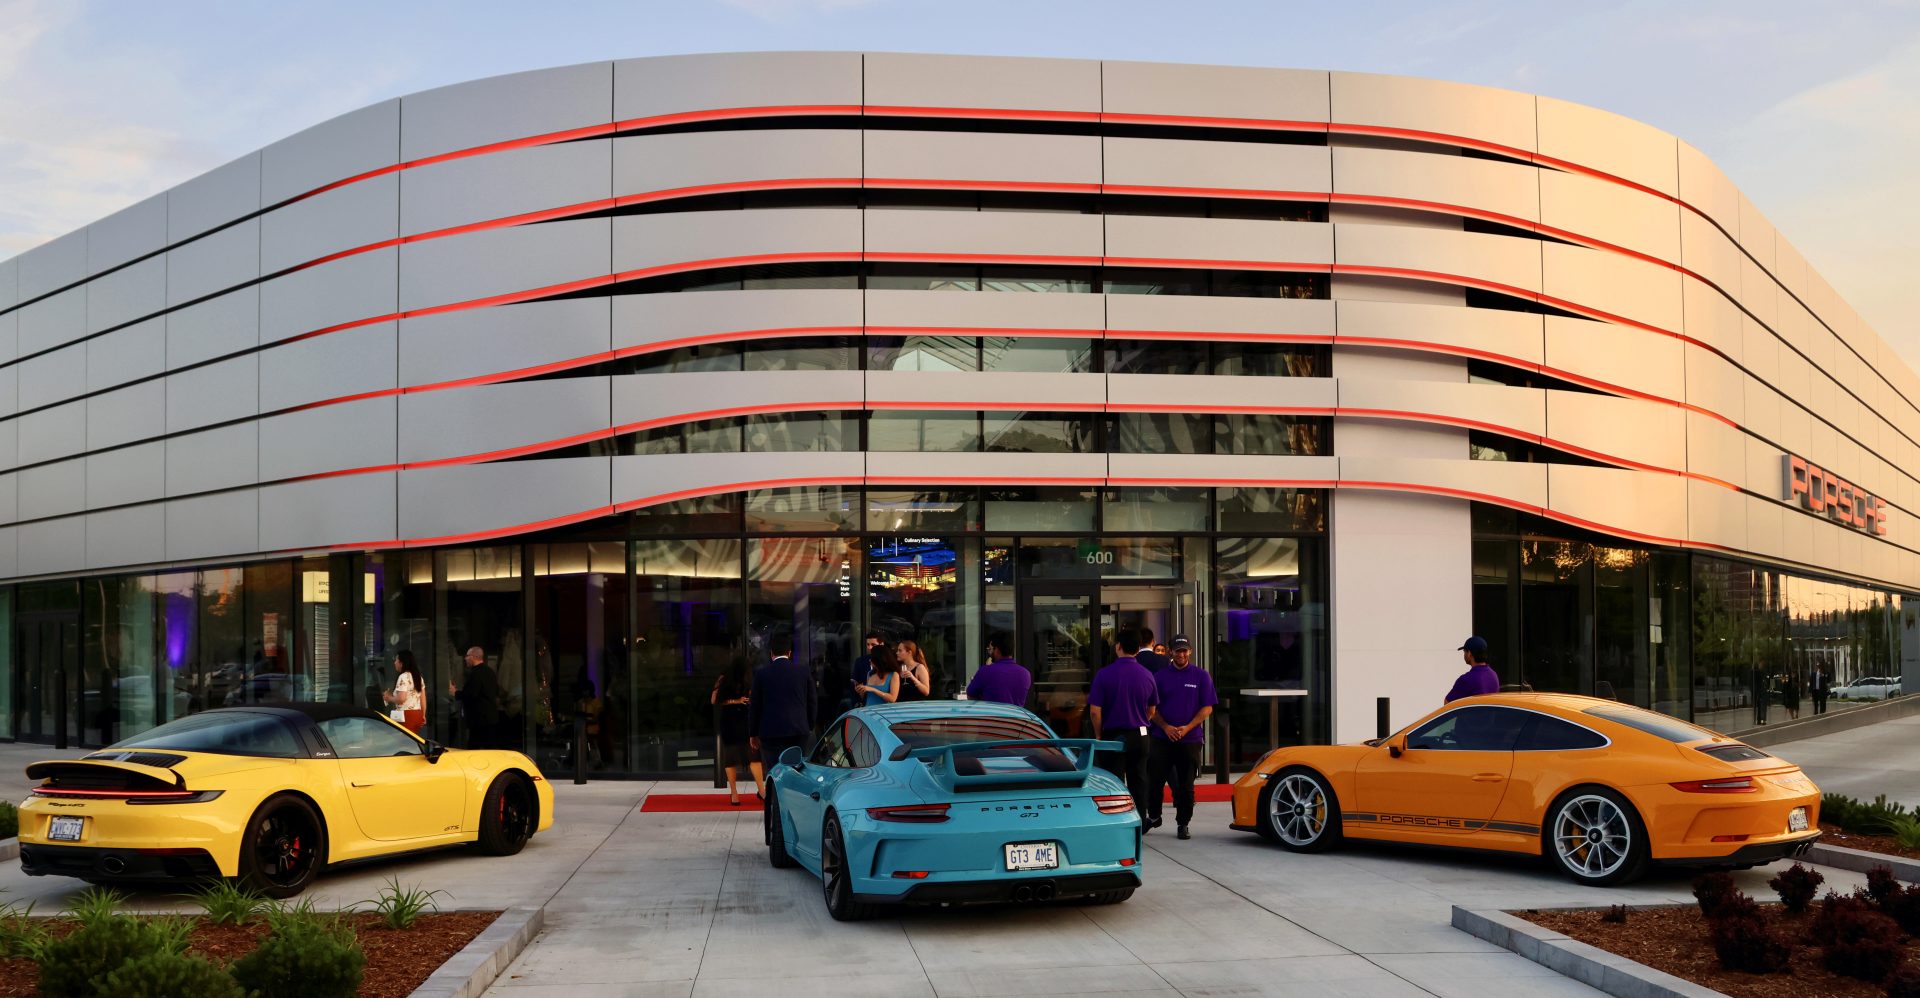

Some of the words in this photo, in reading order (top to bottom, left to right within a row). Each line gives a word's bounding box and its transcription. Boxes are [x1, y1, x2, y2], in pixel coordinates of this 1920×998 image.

[1782, 454, 1886, 536] PORSCHE
[1086, 551, 1113, 564] 600
[981, 803, 1072, 812] PORSCHE
[1380, 815, 1460, 827] PORSCHE
[1010, 849, 1029, 864] GT3
[1035, 847, 1053, 863] 4ME
